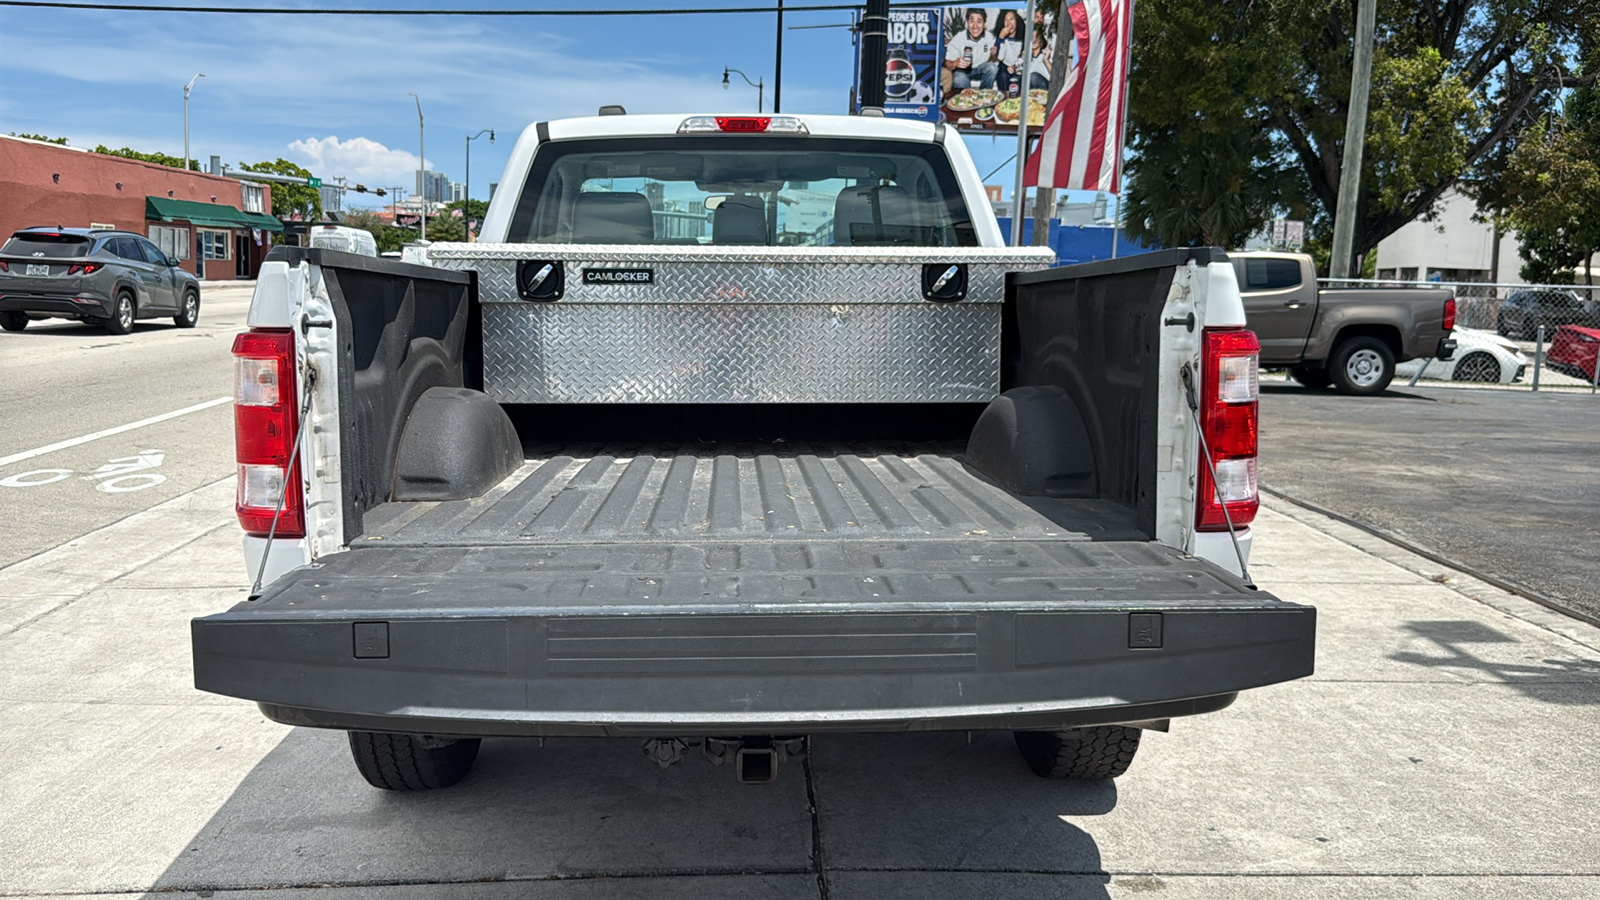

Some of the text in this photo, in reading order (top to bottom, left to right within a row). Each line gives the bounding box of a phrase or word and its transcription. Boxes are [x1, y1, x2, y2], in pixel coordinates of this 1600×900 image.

[888, 12, 930, 22] PEONES DEL
[887, 22, 930, 44] ABOR
[885, 73, 913, 81] EPSI
[586, 272, 650, 281] CAMLOCKER
